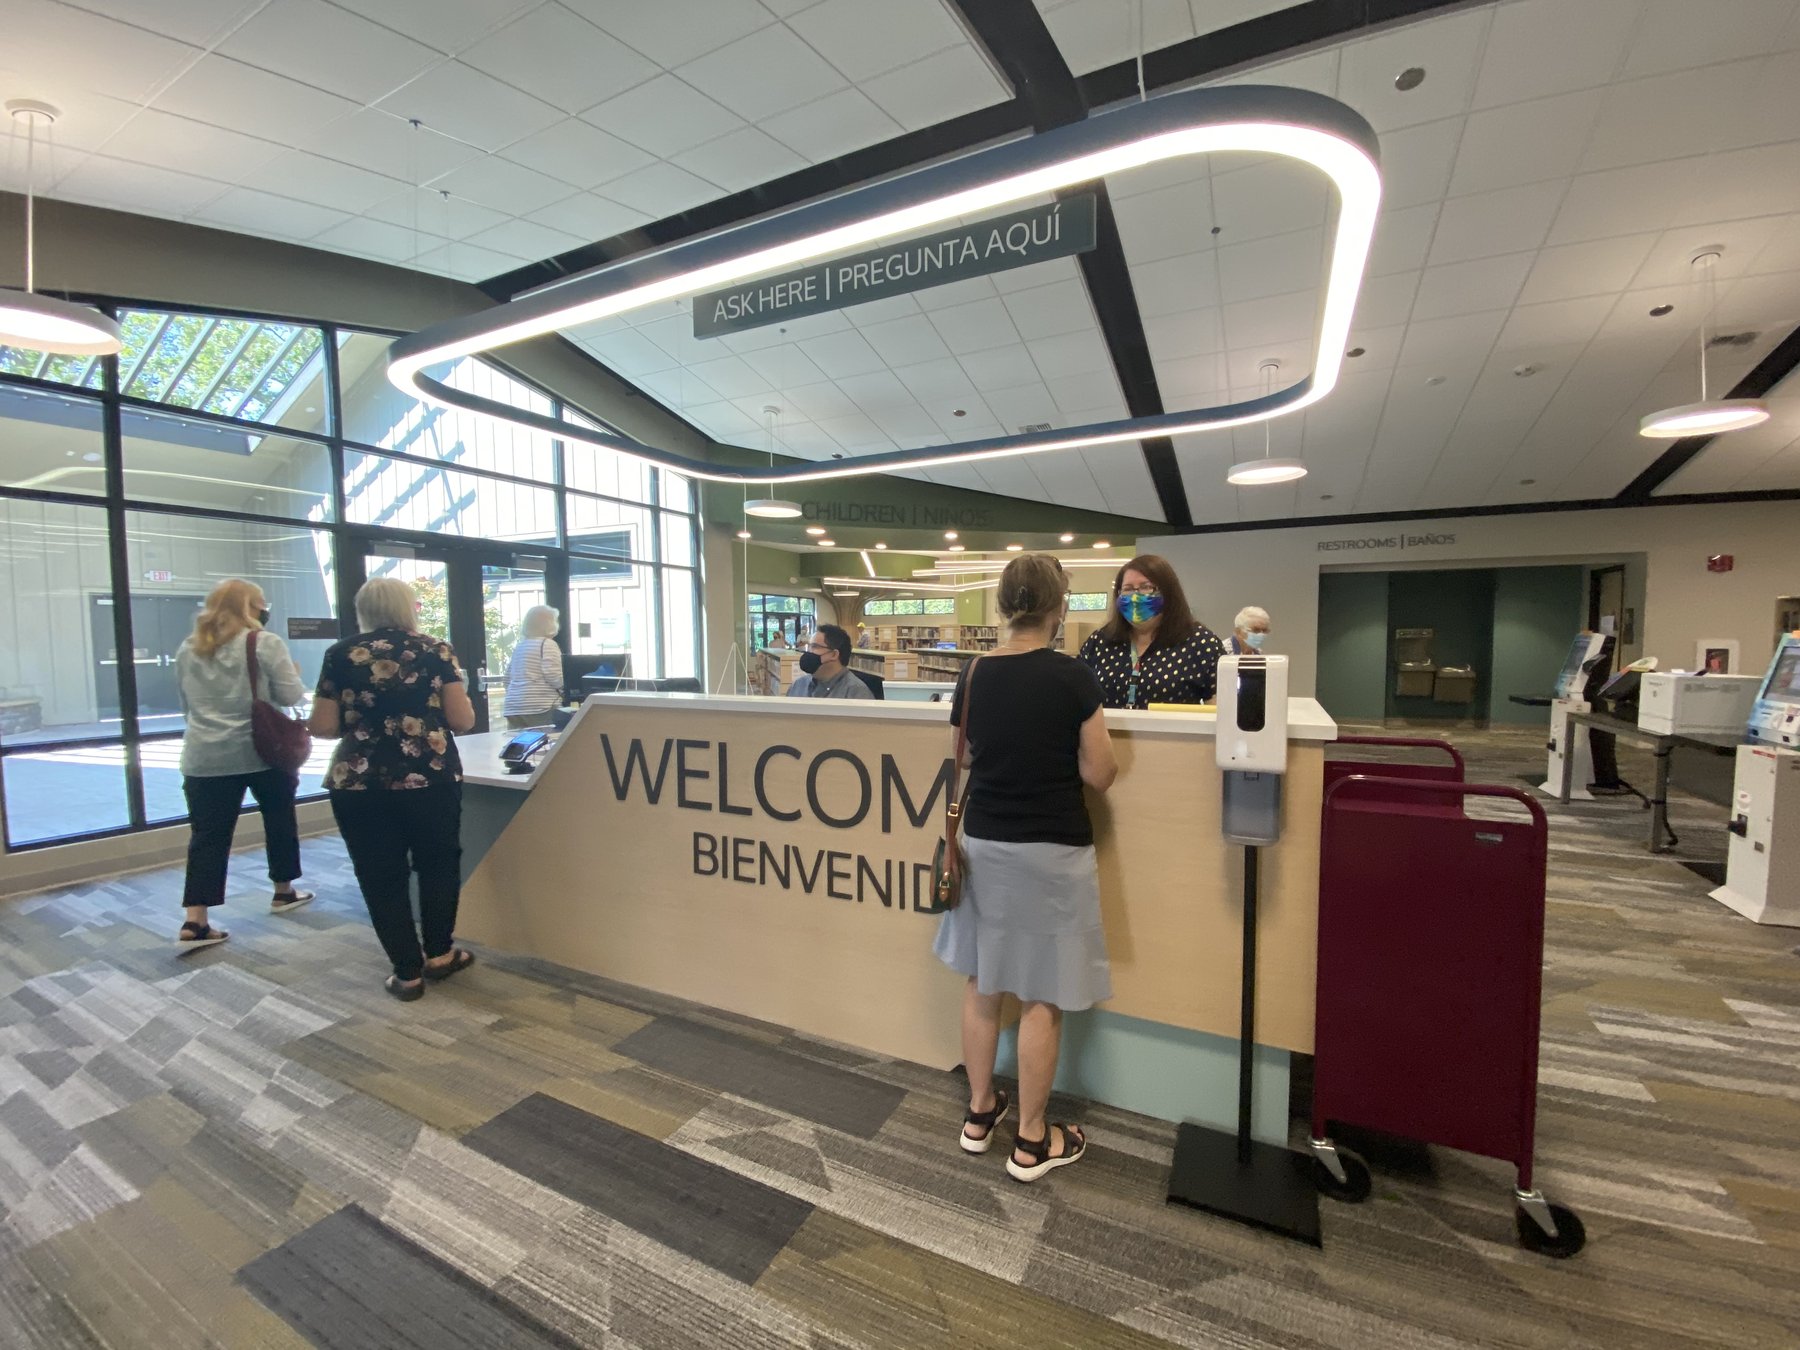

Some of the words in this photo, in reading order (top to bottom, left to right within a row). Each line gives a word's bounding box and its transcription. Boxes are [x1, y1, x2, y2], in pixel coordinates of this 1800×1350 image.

[713, 296, 755, 323] ASK
[759, 276, 817, 312] HERE
[838, 236, 978, 292] PREGUNTA
[985, 204, 1061, 256] AQUÍ
[801, 502, 905, 523] CHILDREN
[1317, 537, 1397, 551] RESTROOMS
[600, 733, 956, 833] WELCOM
[693, 831, 945, 914] BIENVENID
